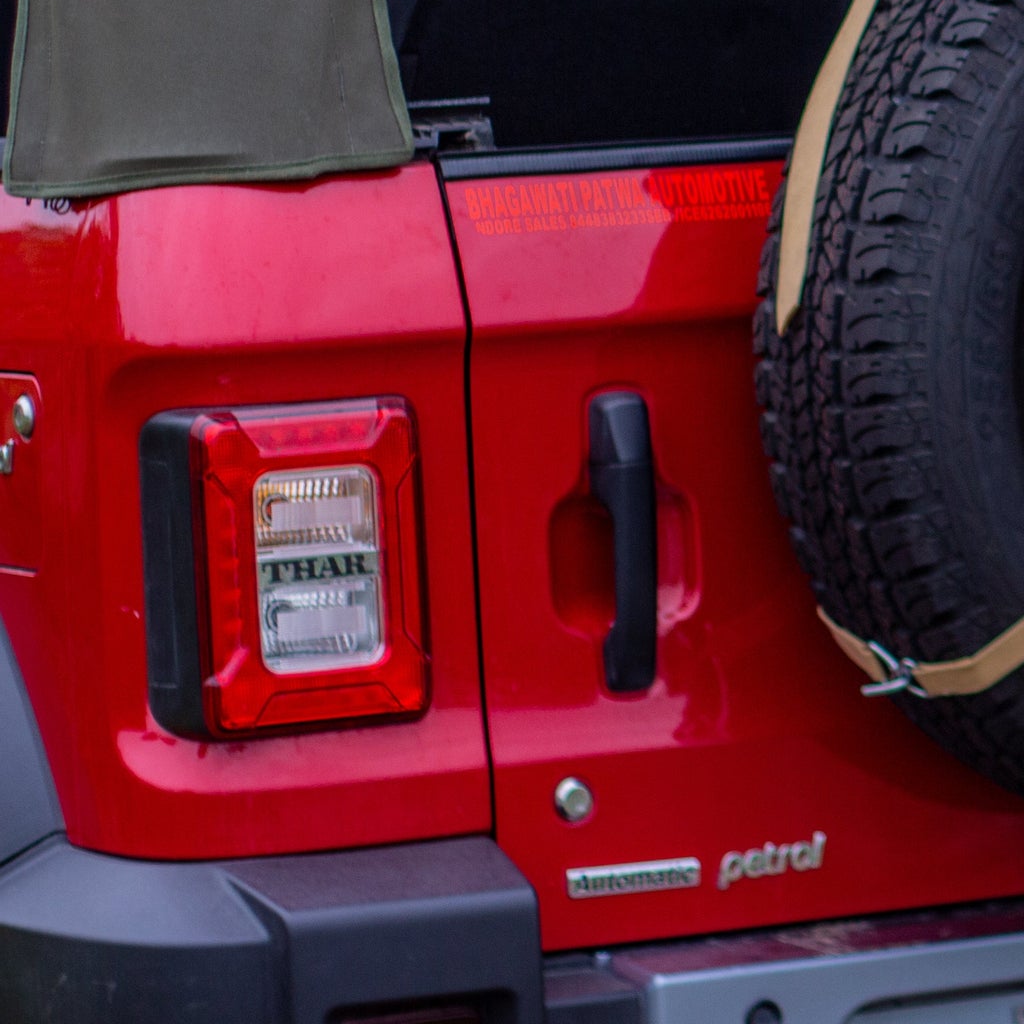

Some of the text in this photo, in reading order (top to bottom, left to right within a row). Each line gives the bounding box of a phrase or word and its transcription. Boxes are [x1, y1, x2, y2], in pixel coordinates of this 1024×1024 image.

[465, 168, 769, 220] BHAGAWATI PATWA AUTOMOTIVE
[262, 554, 372, 583] THAR
[573, 830, 827, 893] Automatic petrol
